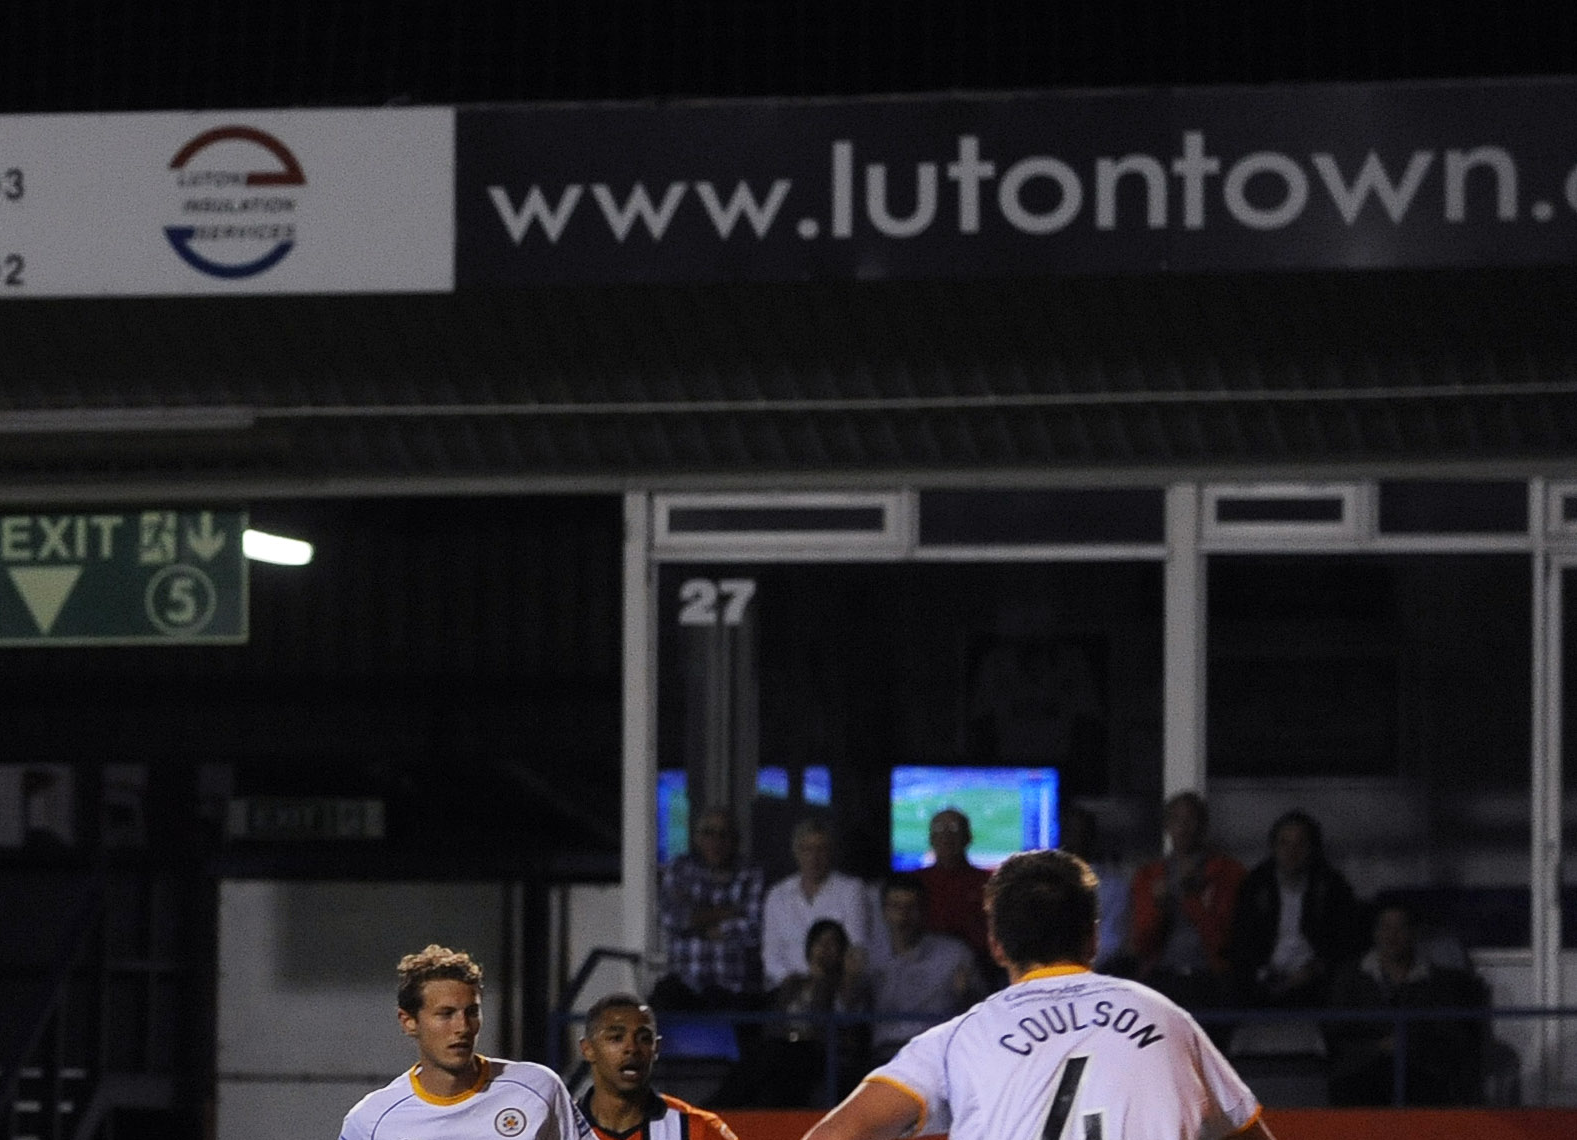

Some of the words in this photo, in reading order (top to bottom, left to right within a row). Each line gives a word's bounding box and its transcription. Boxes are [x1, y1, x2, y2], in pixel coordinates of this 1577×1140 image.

[488, 130, 1577, 244] www.lutontown.
[0, 514, 125, 562] EXIT
[166, 576, 199, 624] 5
[678, 578, 757, 627] 27
[999, 1000, 1165, 1056] COULSON
